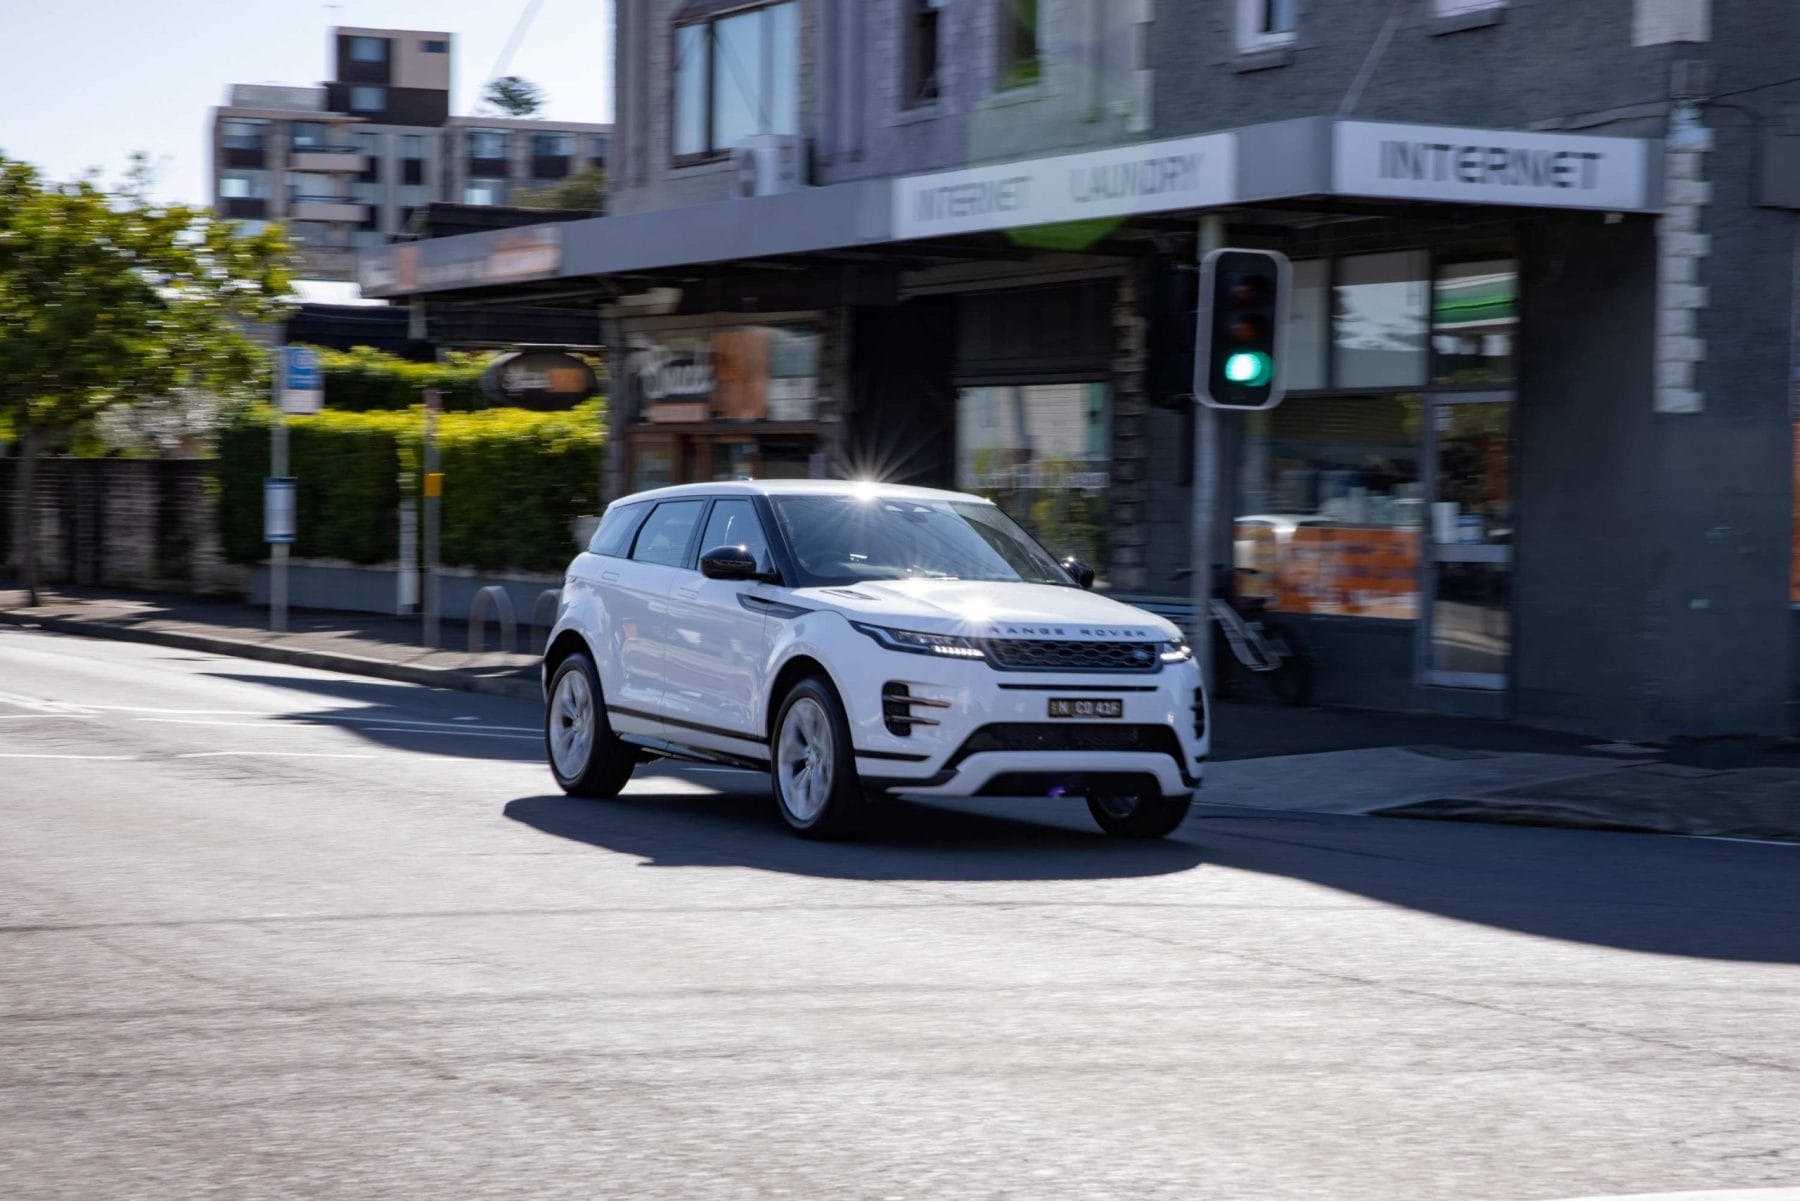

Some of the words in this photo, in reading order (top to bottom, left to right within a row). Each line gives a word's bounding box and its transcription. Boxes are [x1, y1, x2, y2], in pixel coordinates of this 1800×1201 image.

[1379, 140, 1604, 190] INTERNET
[989, 626, 1065, 636] RANGE
[1080, 628, 1146, 638] ROVER
